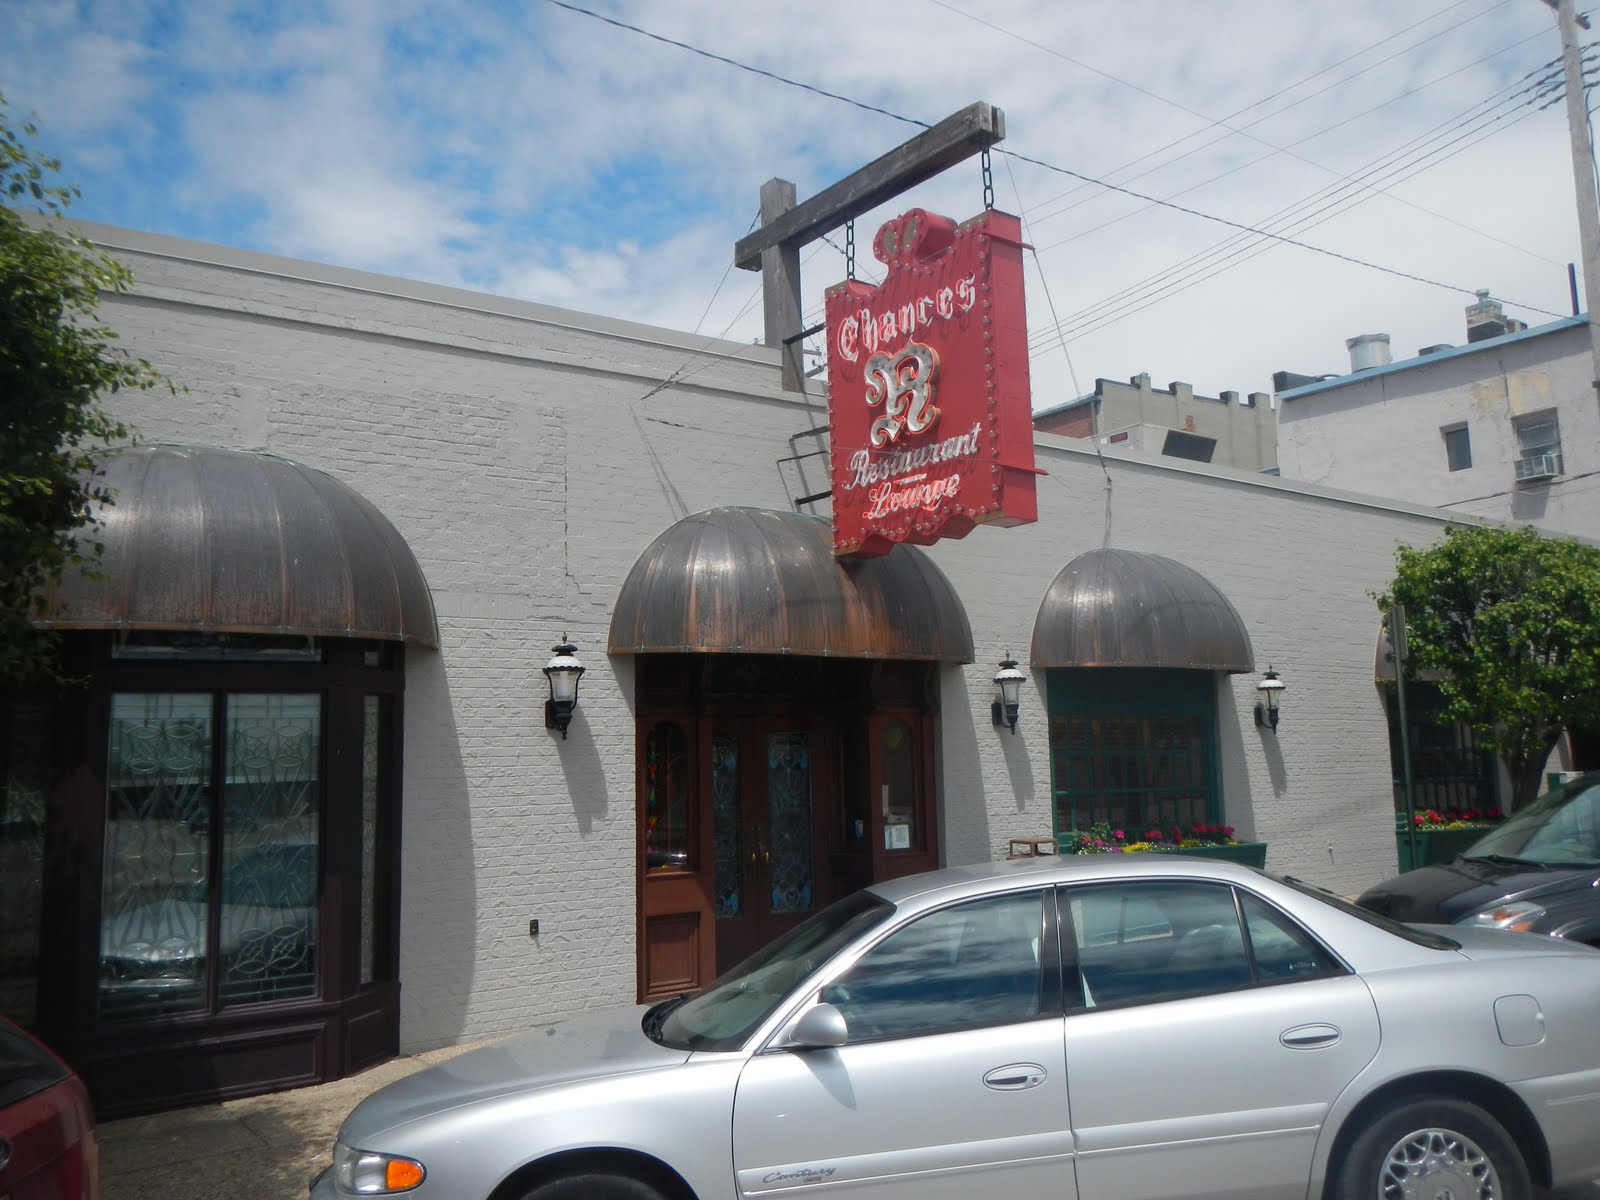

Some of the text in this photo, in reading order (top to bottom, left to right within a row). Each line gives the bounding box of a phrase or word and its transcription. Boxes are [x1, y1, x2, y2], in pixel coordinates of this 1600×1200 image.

[837, 271, 976, 363] Chances
[842, 421, 982, 490] Restaurant
[862, 474, 960, 520] Lounge
[762, 1167, 836, 1184] Century
